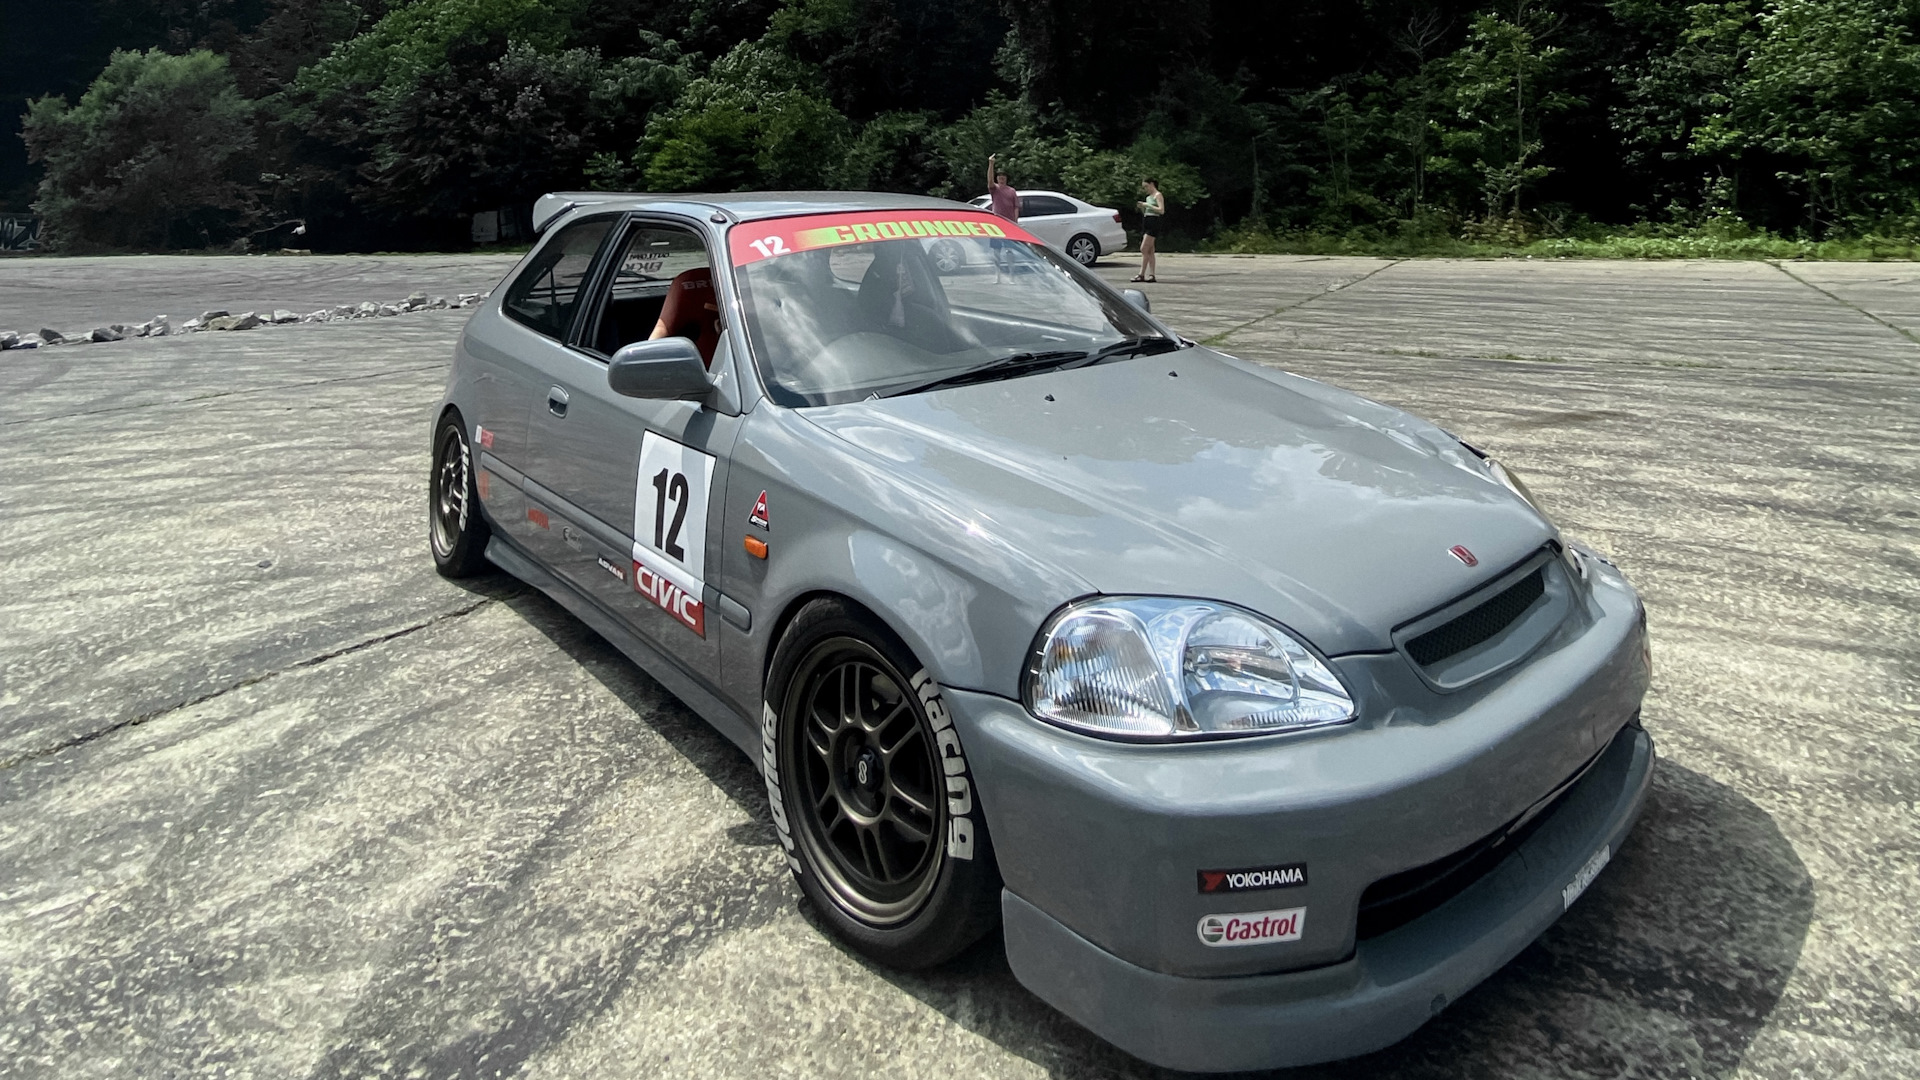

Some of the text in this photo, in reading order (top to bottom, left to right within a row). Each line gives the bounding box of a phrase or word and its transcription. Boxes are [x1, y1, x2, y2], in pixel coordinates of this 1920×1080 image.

[834, 220, 1006, 242] GROUNDED
[749, 235, 791, 257] 12
[652, 467, 689, 563] 12
[636, 565, 700, 626] CIVIC
[910, 667, 974, 860] Racing
[1226, 867, 1304, 889] YOKOHAMA
[1225, 913, 1297, 941] Castrol
